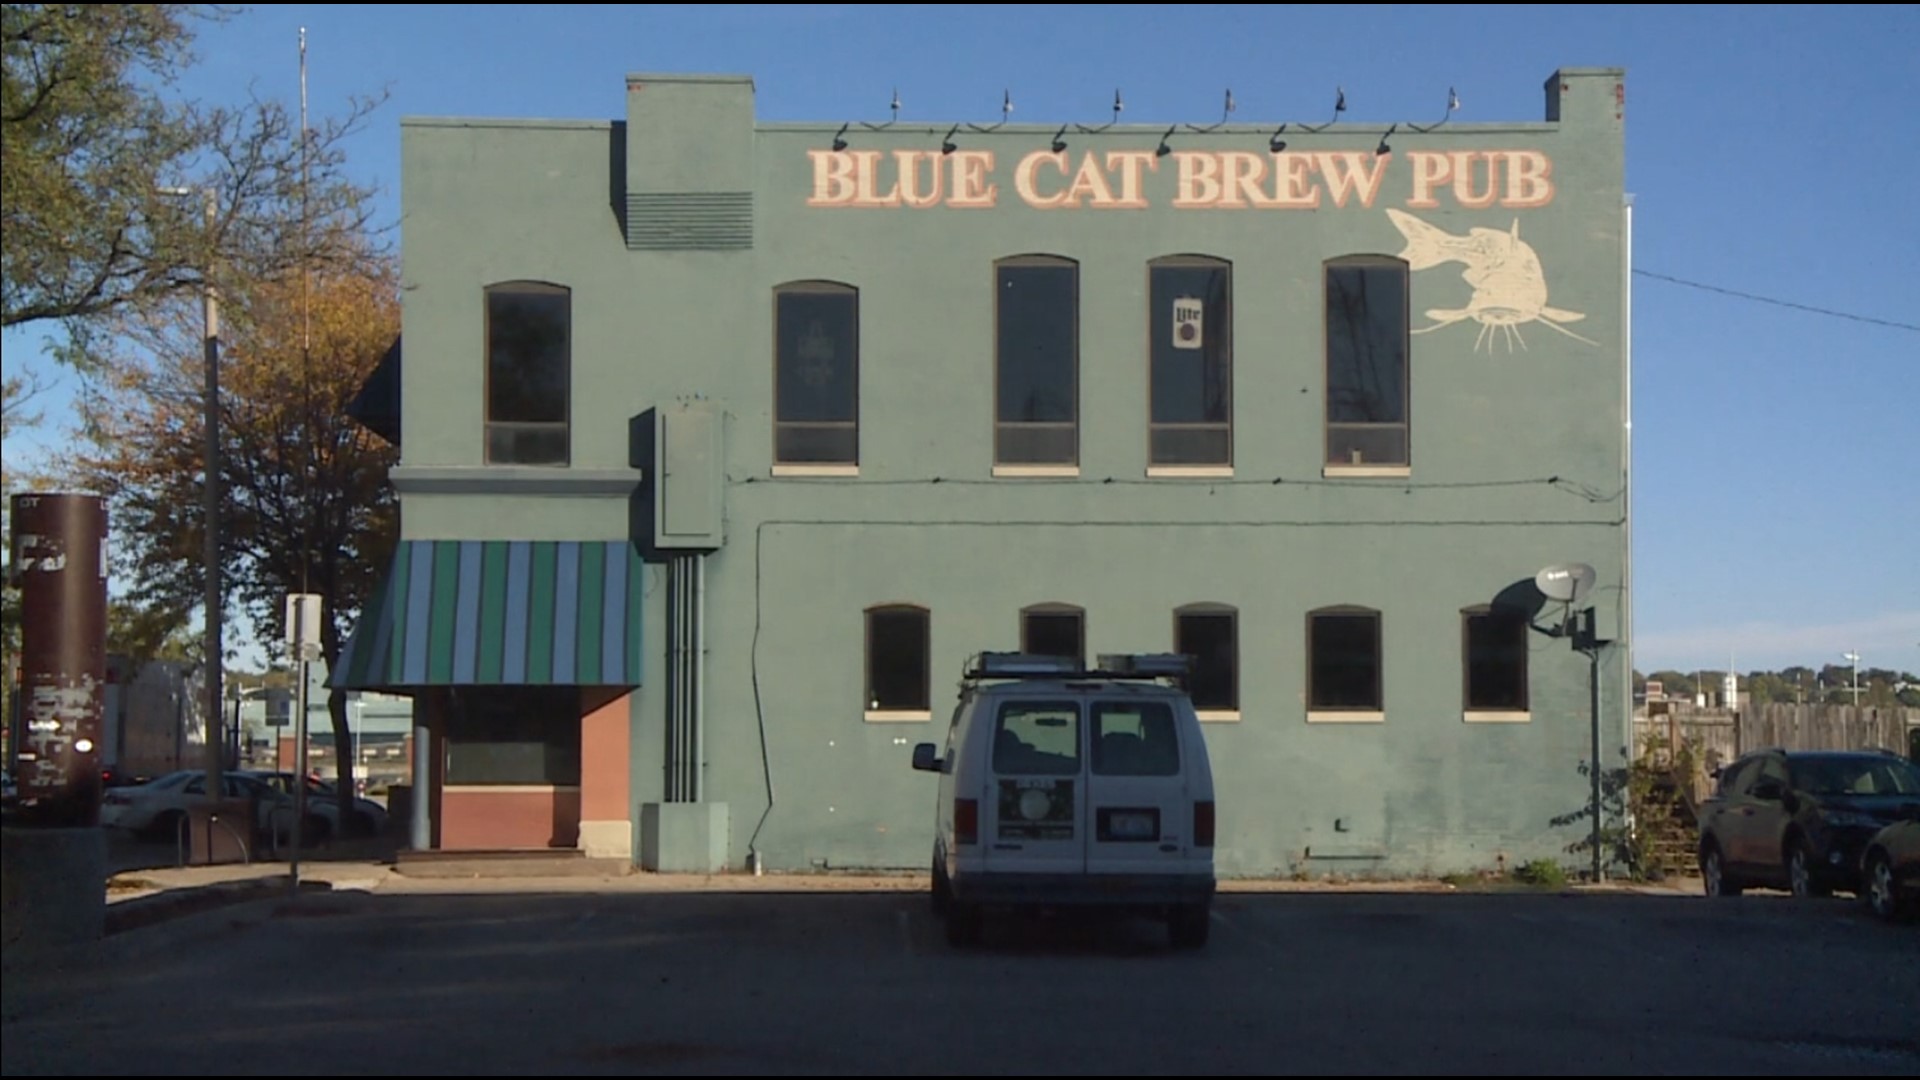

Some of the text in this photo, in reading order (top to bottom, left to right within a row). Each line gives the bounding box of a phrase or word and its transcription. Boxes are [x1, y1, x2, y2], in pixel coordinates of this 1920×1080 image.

[806, 149, 1554, 210] BLUE CAT BREW PUB
